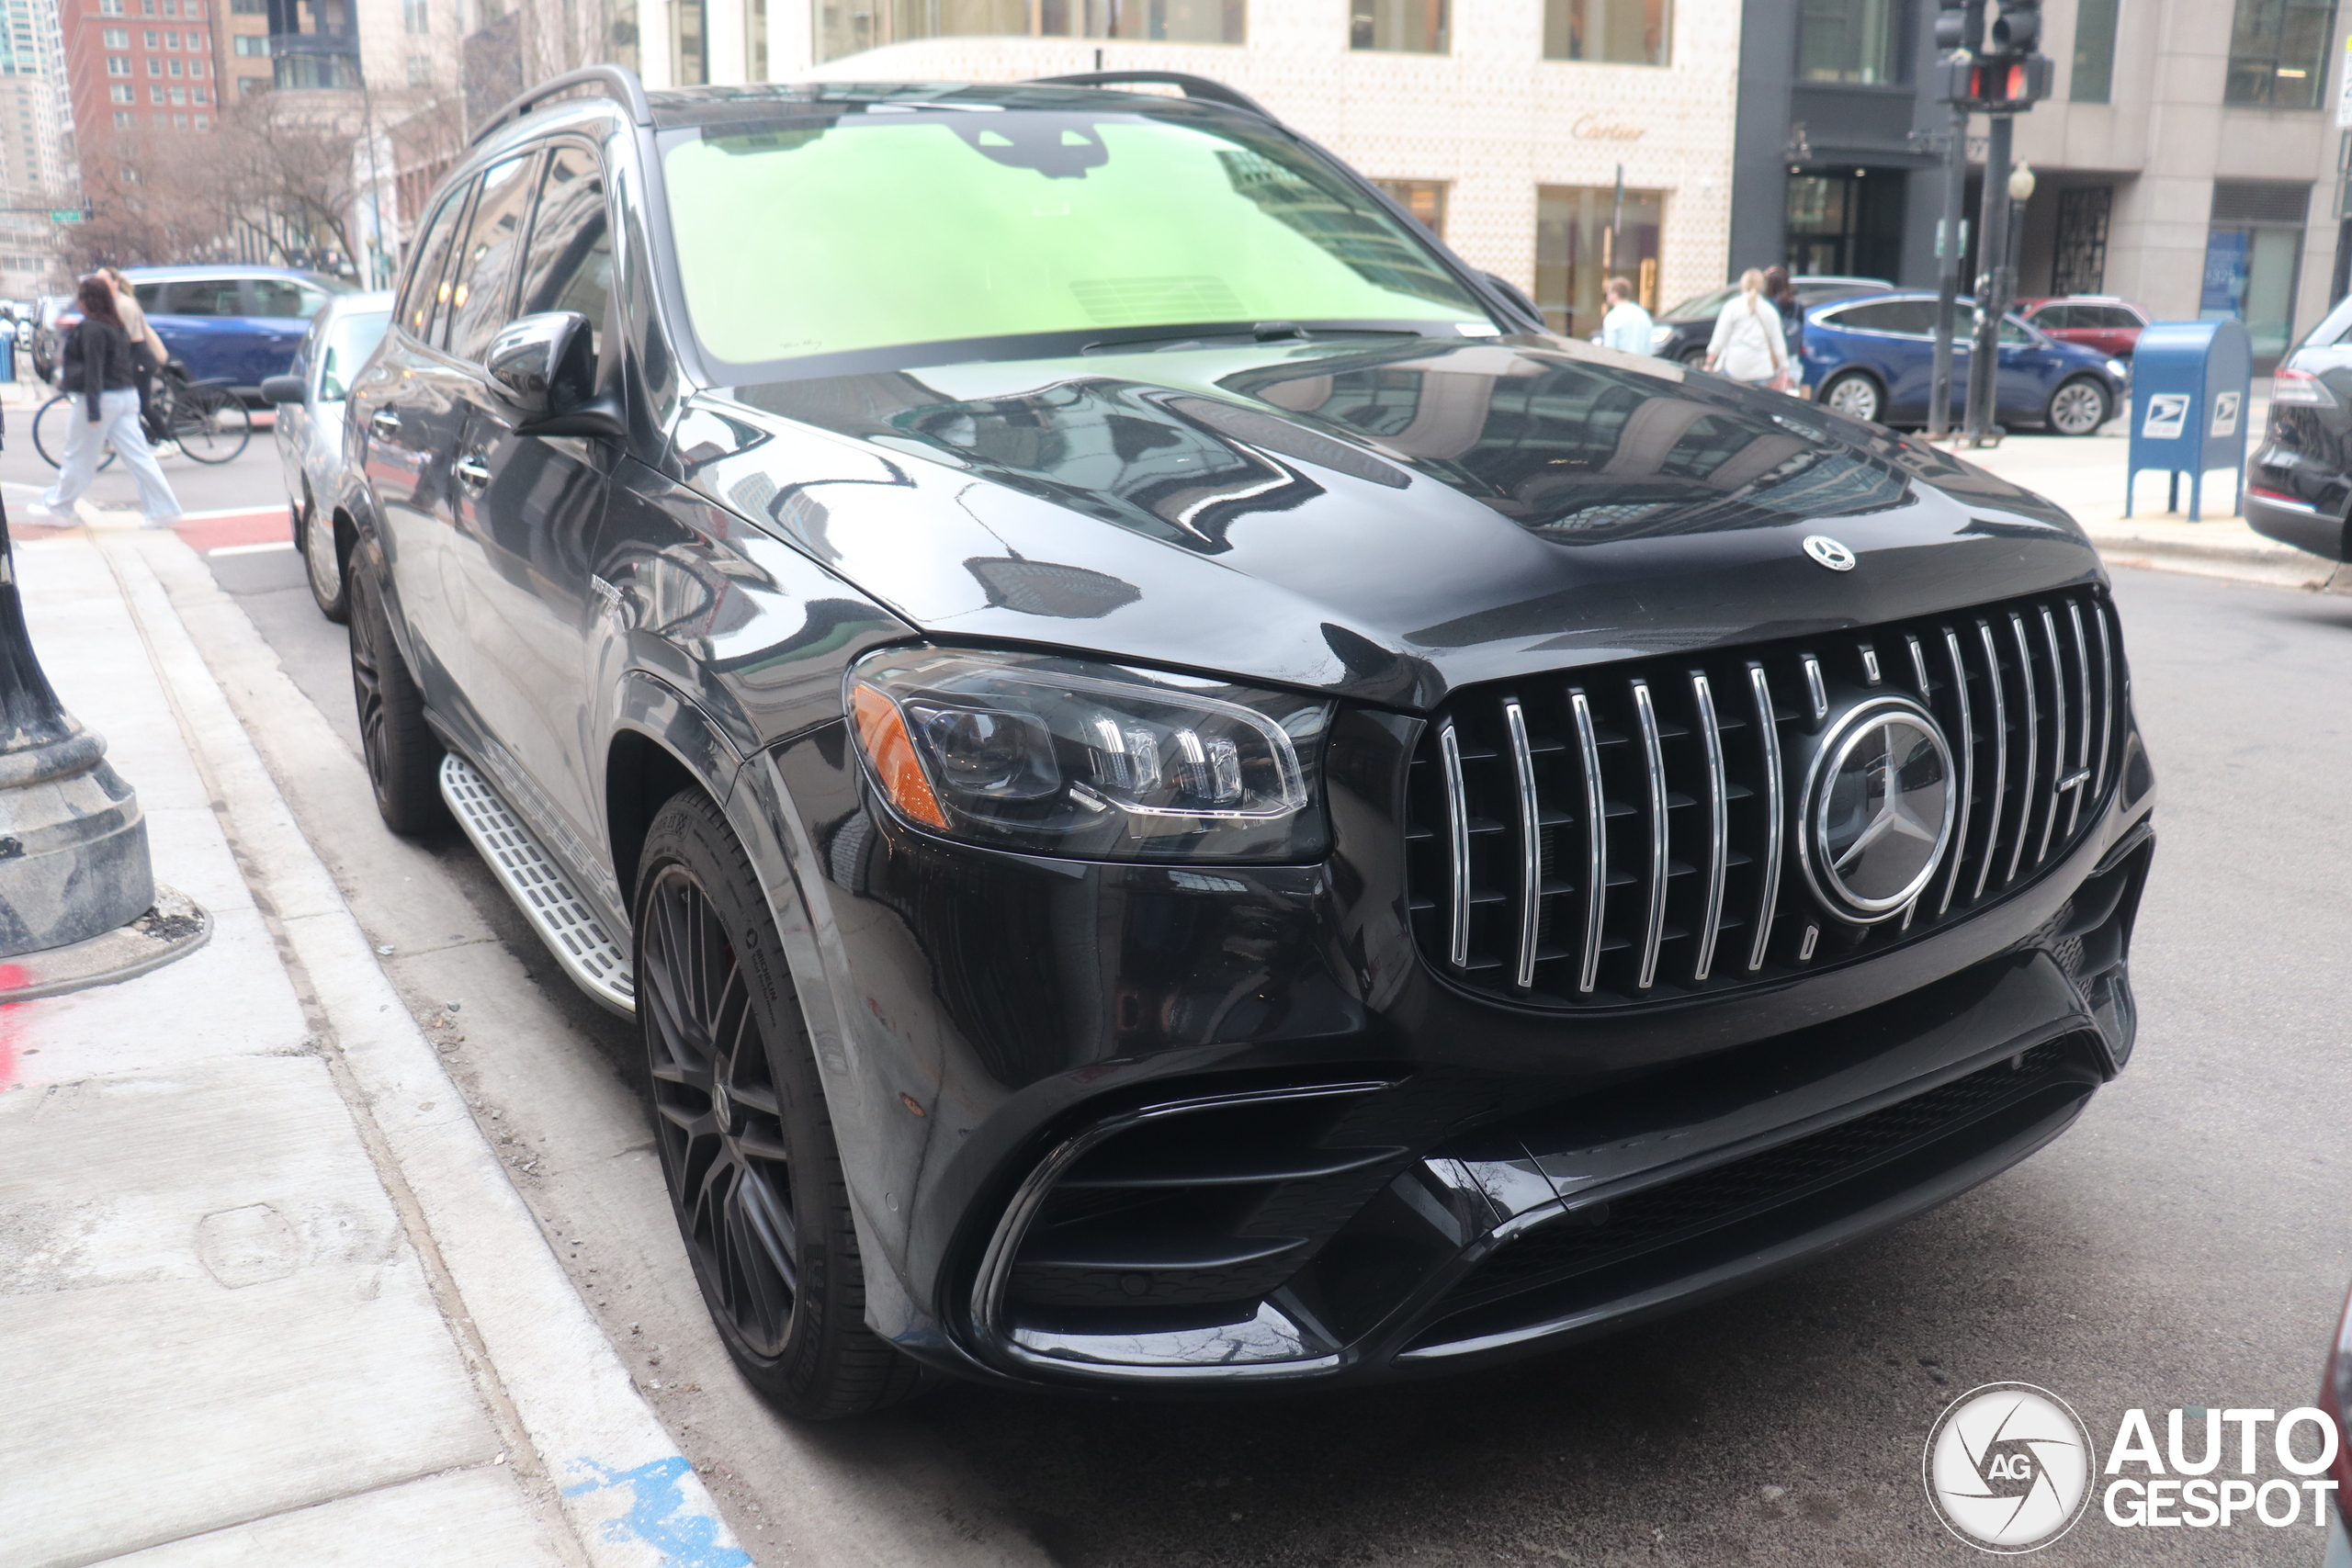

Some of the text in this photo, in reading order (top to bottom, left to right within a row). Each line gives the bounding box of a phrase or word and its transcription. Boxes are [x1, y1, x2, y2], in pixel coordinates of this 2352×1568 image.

[1571, 111, 1648, 140] Cartier
[752, 953, 777, 1028] Total Performance
[755, 948, 777, 1001] MICHELIN
